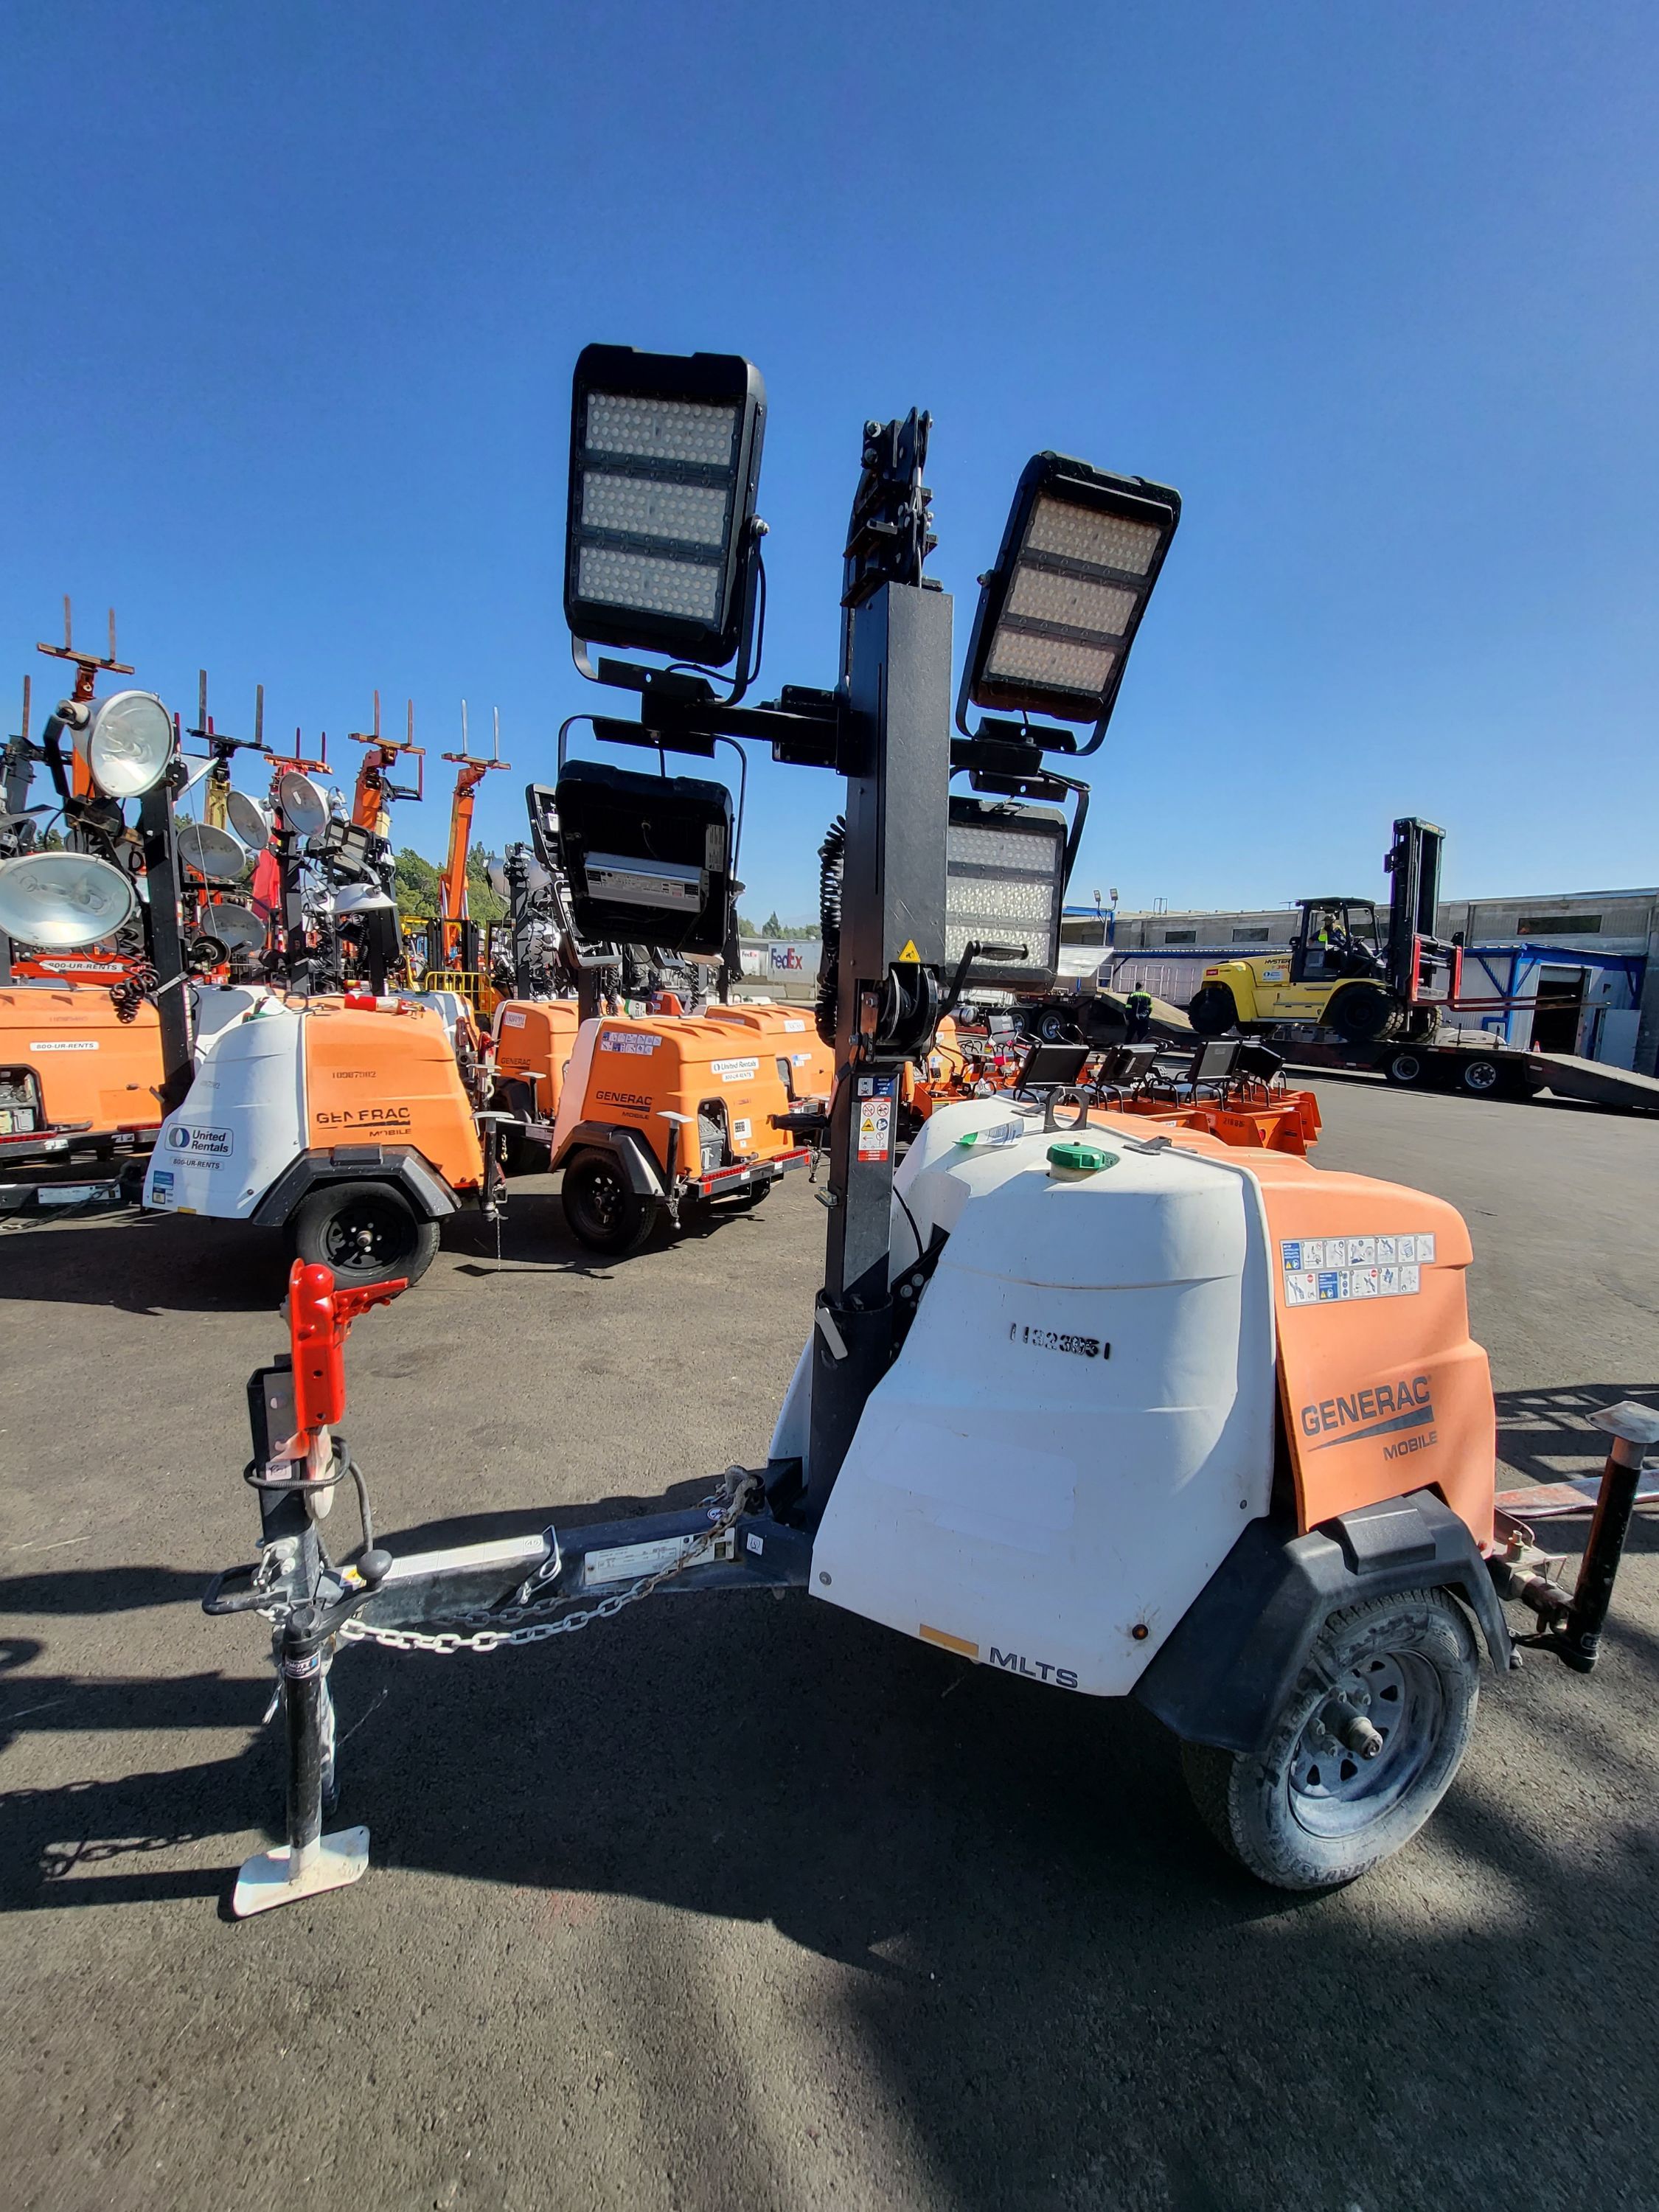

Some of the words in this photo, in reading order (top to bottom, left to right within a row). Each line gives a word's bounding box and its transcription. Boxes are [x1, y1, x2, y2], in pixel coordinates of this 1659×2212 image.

[771, 947, 803, 970] FedEx
[501, 1057, 532, 1066] GENERAC
[720, 1062, 738, 1070] United
[739, 1060, 757, 1068] Rentals
[596, 1091, 653, 1106] GENERAC
[621, 1110, 650, 1120] MOBILE
[192, 1129, 226, 1142] United
[191, 1140, 229, 1153] Rentals
[173, 1158, 220, 1169] 800-UR-RENTS
[1301, 1375, 1431, 1437] GENERAC
[1382, 1430, 1438, 1461] MOBILE
[990, 1646, 1079, 1688] MLTS
